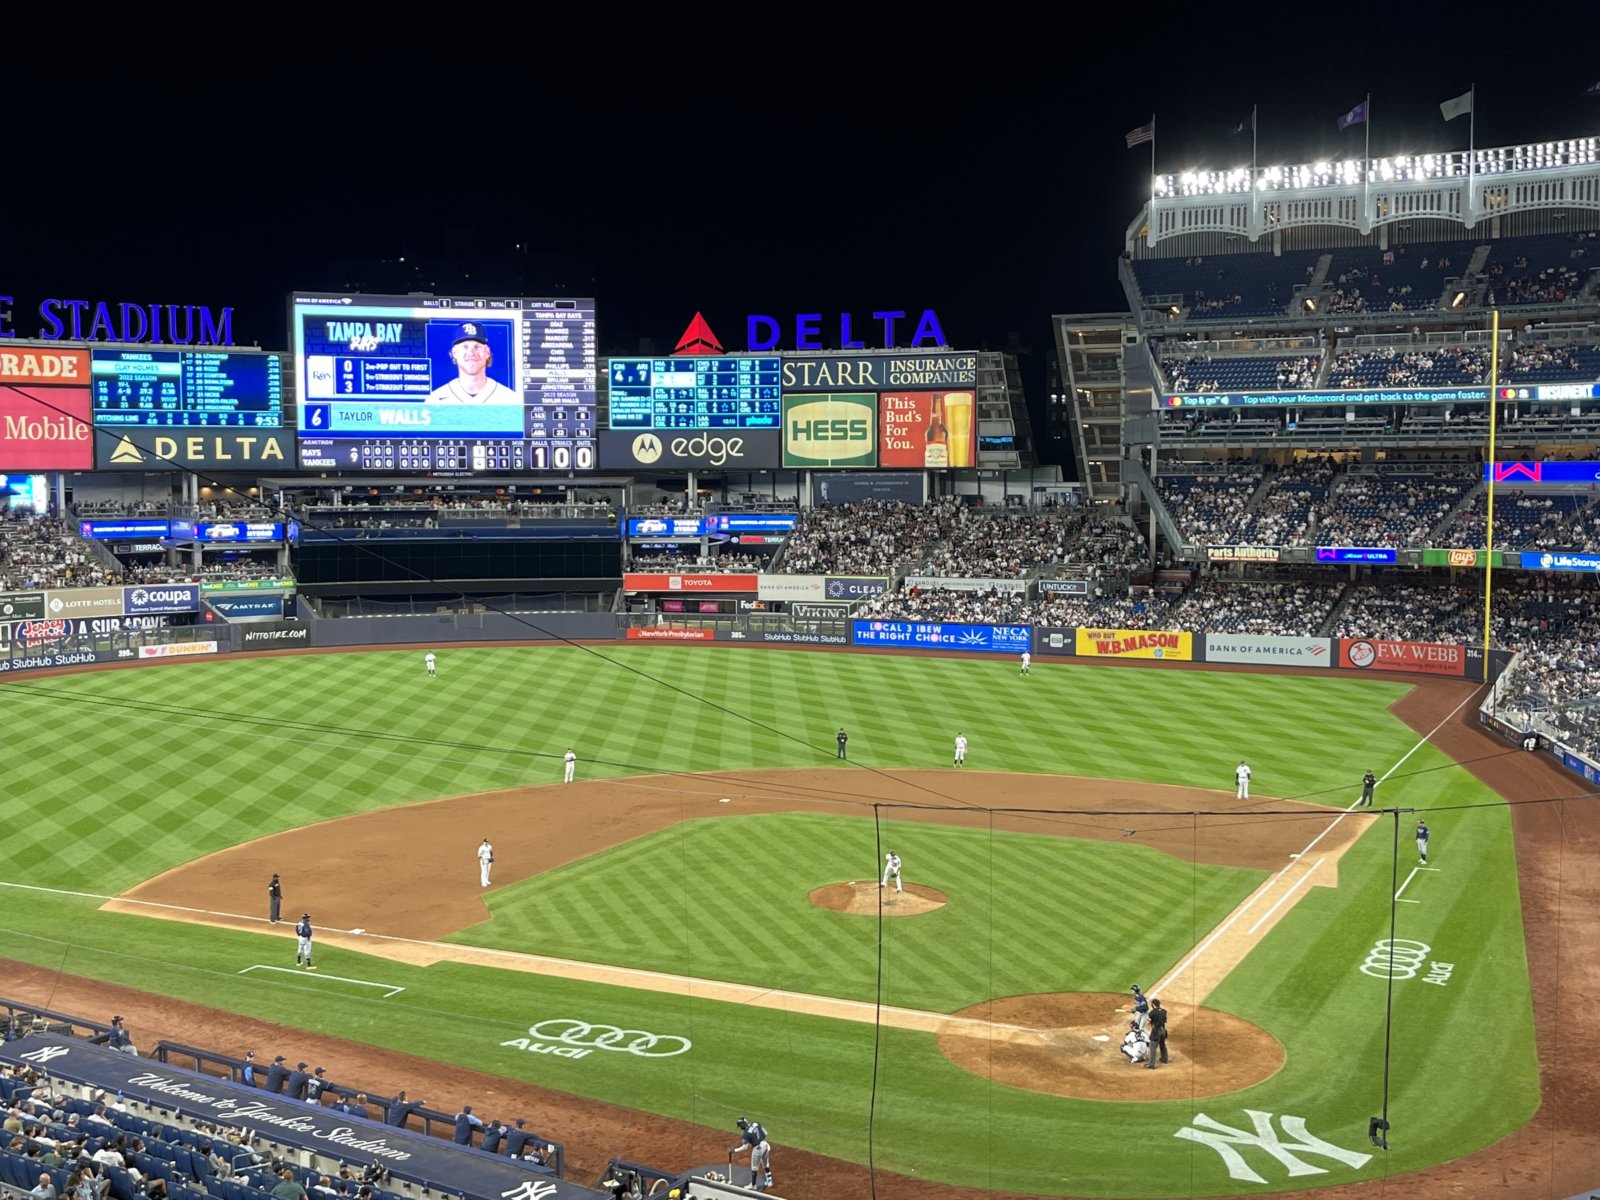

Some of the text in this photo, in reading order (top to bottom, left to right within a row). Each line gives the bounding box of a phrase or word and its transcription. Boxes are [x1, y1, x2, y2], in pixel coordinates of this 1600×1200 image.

[40, 298, 235, 347] STADIUM
[326, 322, 402, 342] TAMPA BAY
[748, 309, 949, 350] DELTA
[782, 361, 879, 387] STARR
[889, 357, 976, 372] INSURANCE
[889, 370, 976, 385] COMPANIES
[345, 381, 353, 393] 3
[885, 397, 916, 409] This
[1183, 396, 1198, 405] Tap
[1243, 395, 1258, 405] Tap
[1259, 395, 1277, 403] with
[1279, 396, 1296, 405] your
[1297, 394, 1345, 403] Mastercard
[1345, 393, 1362, 401] and
[1364, 394, 1379, 402] get
[1381, 392, 1401, 400] back
[1414, 392, 1429, 400] the
[1431, 393, 1456, 401] game
[1457, 391, 1486, 399] faster.
[255, 417, 279, 427] 9:53
[311, 408, 321, 426] 6
[339, 409, 431, 426] TAYLOR WALLS
[885, 410, 922, 423] Bud's
[5, 416, 89, 442] Mobile
[792, 420, 867, 441] HESS
[885, 425, 908, 436] For
[156, 437, 284, 460] DELTA
[671, 432, 744, 466] edge
[885, 437, 914, 449] You.
[301, 449, 321, 457] RAYS
[534, 447, 591, 468] 1 0 0
[302, 458, 337, 467] YANKEES
[1207, 546, 1280, 559] Parts Authority
[849, 585, 883, 594] CLEAR
[149, 590, 191, 604] coupa
[66, 600, 92, 608] LOTTE
[740, 600, 765, 609] FedEx
[795, 605, 846, 618] VIKING
[869, 622, 902, 632] LOCAL
[916, 625, 942, 633] IBEW
[992, 627, 1028, 636] NECA
[764, 633, 846, 643] StubHub StubHub StubHub
[857, 631, 955, 643] THE RIGHT CHOICE
[1240, 645, 1252, 653] OF
[1255, 646, 1303, 655] AMERICA
[1411, 645, 1458, 663] WEBB
[13, 656, 52, 669] StubHub
[55, 653, 95, 665] StubHub
[1421, 960, 1455, 986] Audi
[500, 1038, 593, 1059] Audi
[128, 1072, 411, 1161] Welcome to Yankee Stadium
